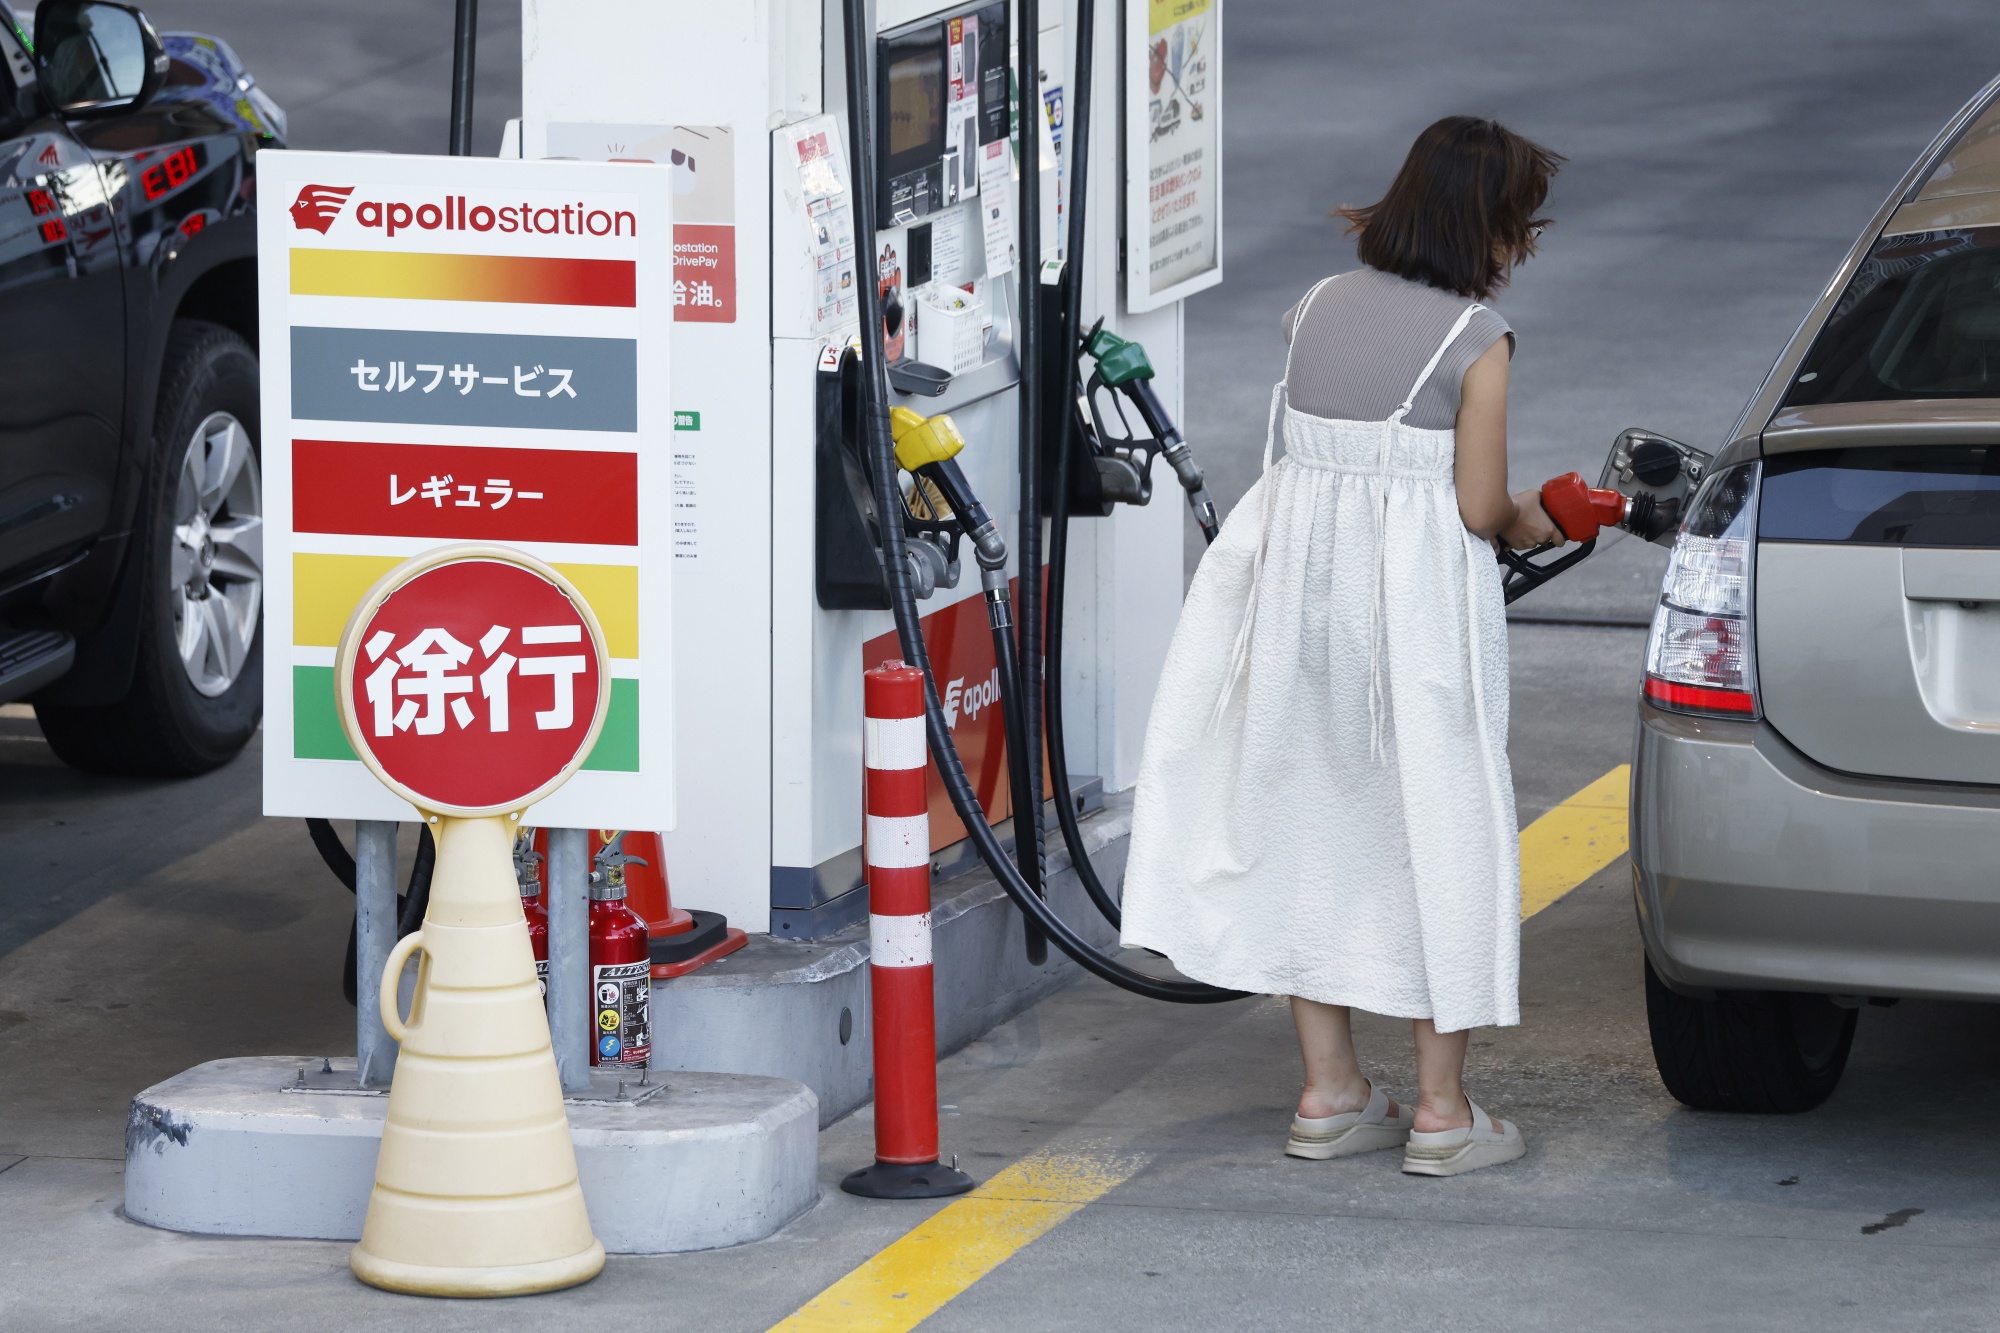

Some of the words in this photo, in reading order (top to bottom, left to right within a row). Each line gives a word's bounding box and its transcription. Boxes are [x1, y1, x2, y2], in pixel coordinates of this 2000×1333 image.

[356, 195, 637, 238] apollostation
[673, 255, 718, 269] DrivePay
[350, 359, 578, 399] セルフサービス
[389, 474, 544, 510] レギュラー
[364, 624, 586, 737] 徐行
[963, 666, 1001, 721] apoll
